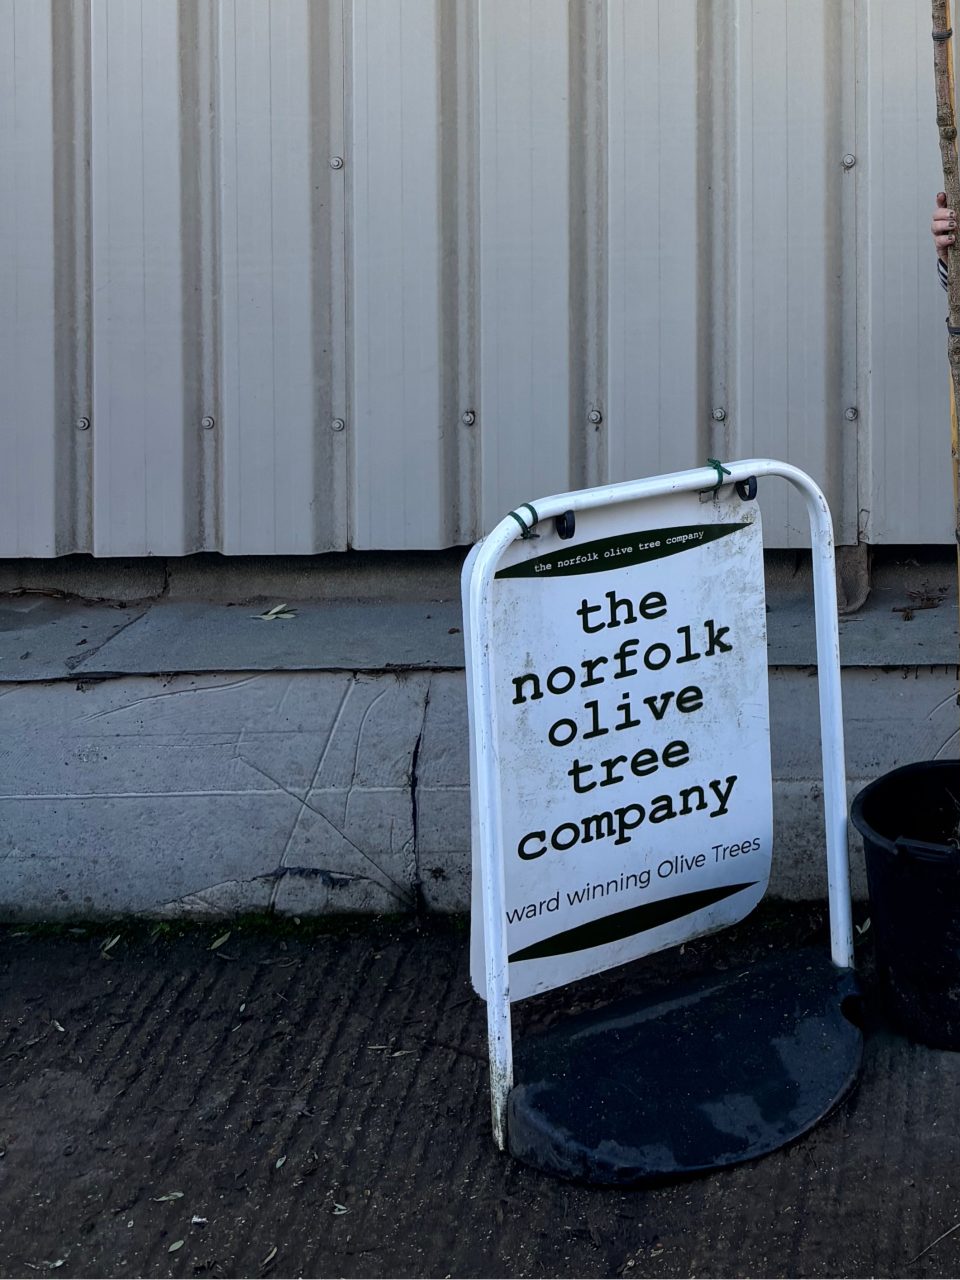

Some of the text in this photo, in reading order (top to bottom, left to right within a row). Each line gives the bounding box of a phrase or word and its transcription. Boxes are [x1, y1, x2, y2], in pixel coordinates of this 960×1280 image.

[534, 530, 705, 572] the norfolk olive tree company
[576, 590, 668, 634] the
[511, 619, 733, 705] norfolk
[547, 683, 704, 747] olive
[567, 738, 690, 795] tree
[516, 773, 738, 861] company
[505, 836, 761, 924] ward winning Olive Trees
